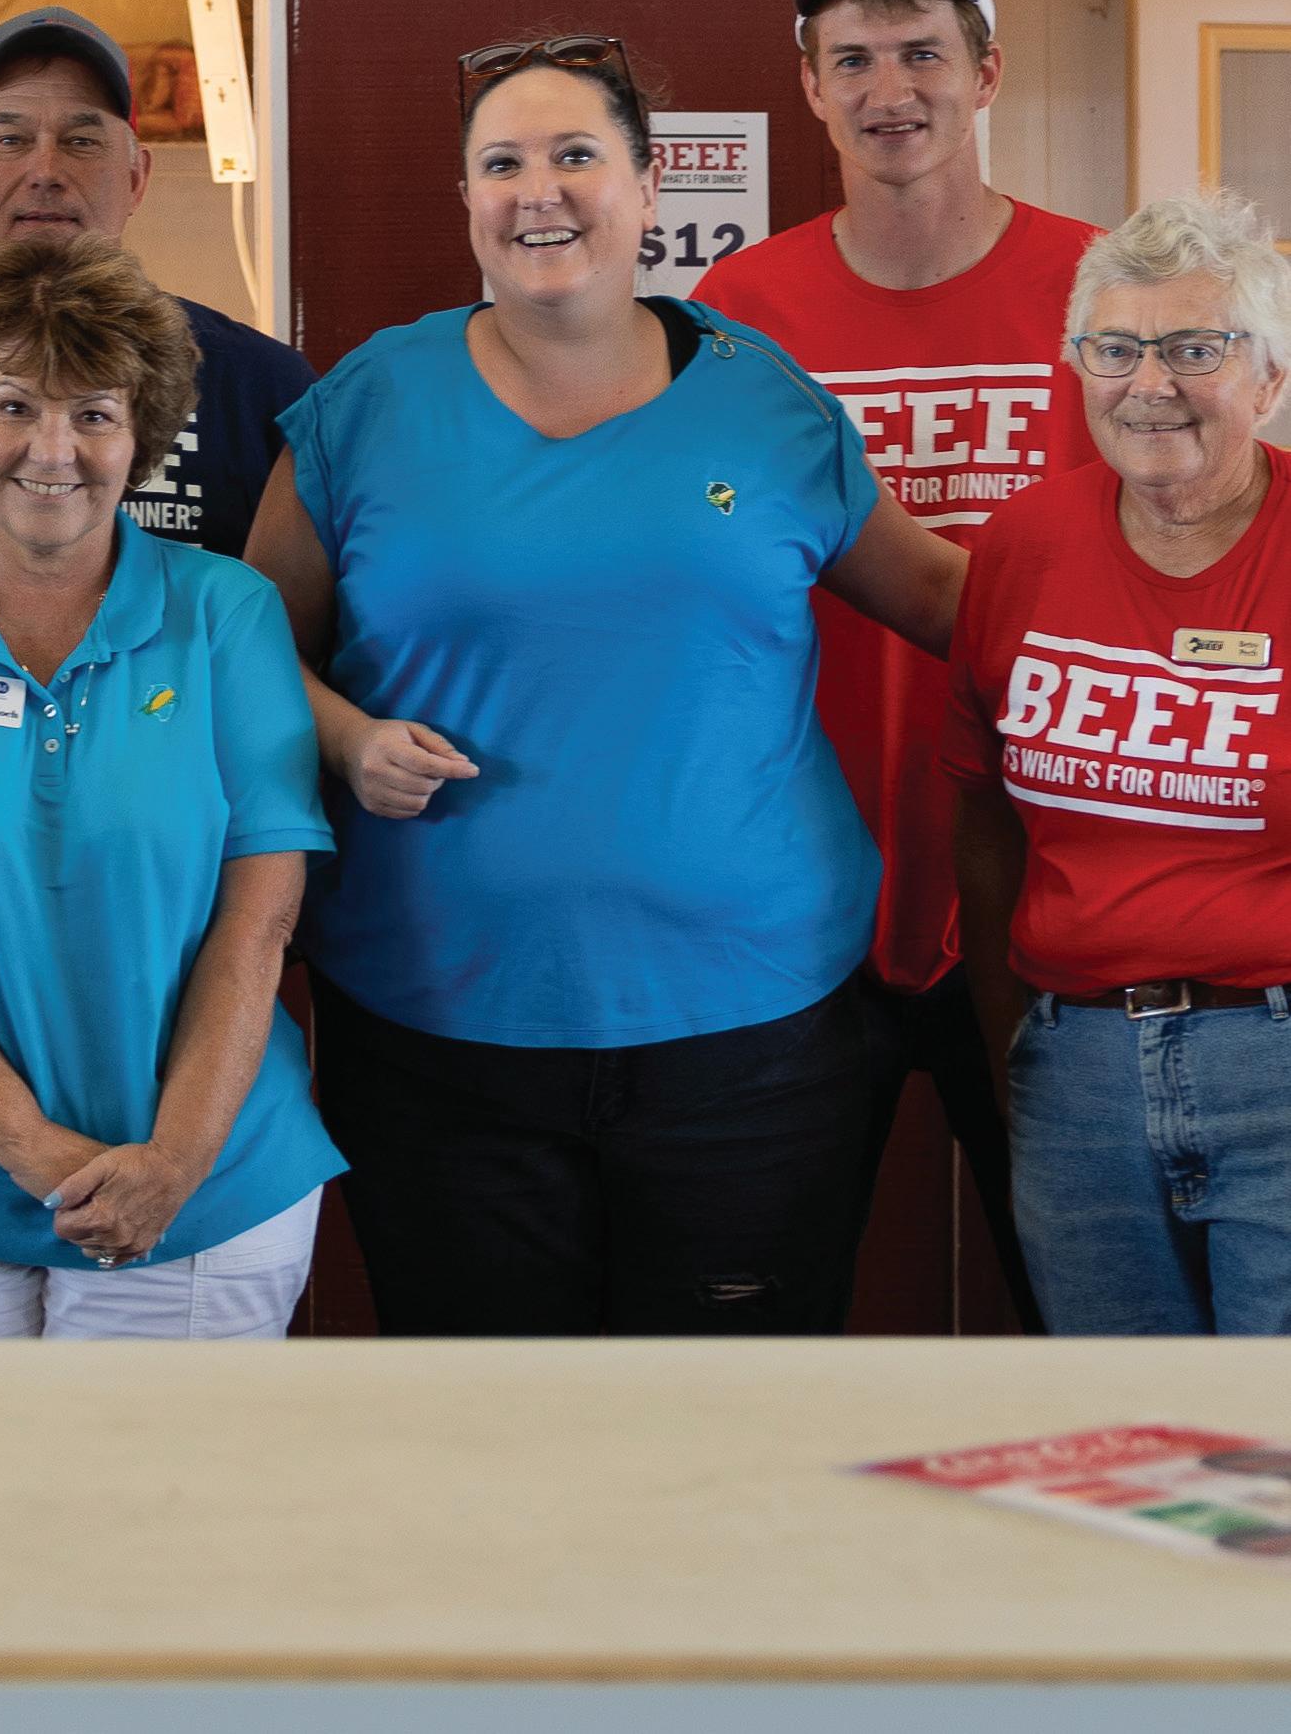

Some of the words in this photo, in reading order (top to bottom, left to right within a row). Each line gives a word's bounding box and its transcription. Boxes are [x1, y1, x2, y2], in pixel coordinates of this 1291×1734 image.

[841, 387, 1051, 469] EEF.
[900, 476, 943, 504] FOR
[996, 655, 1279, 771] BEEF.
[1021, 749, 1102, 790] WHAT'S
[1105, 764, 1154, 797] FOR
